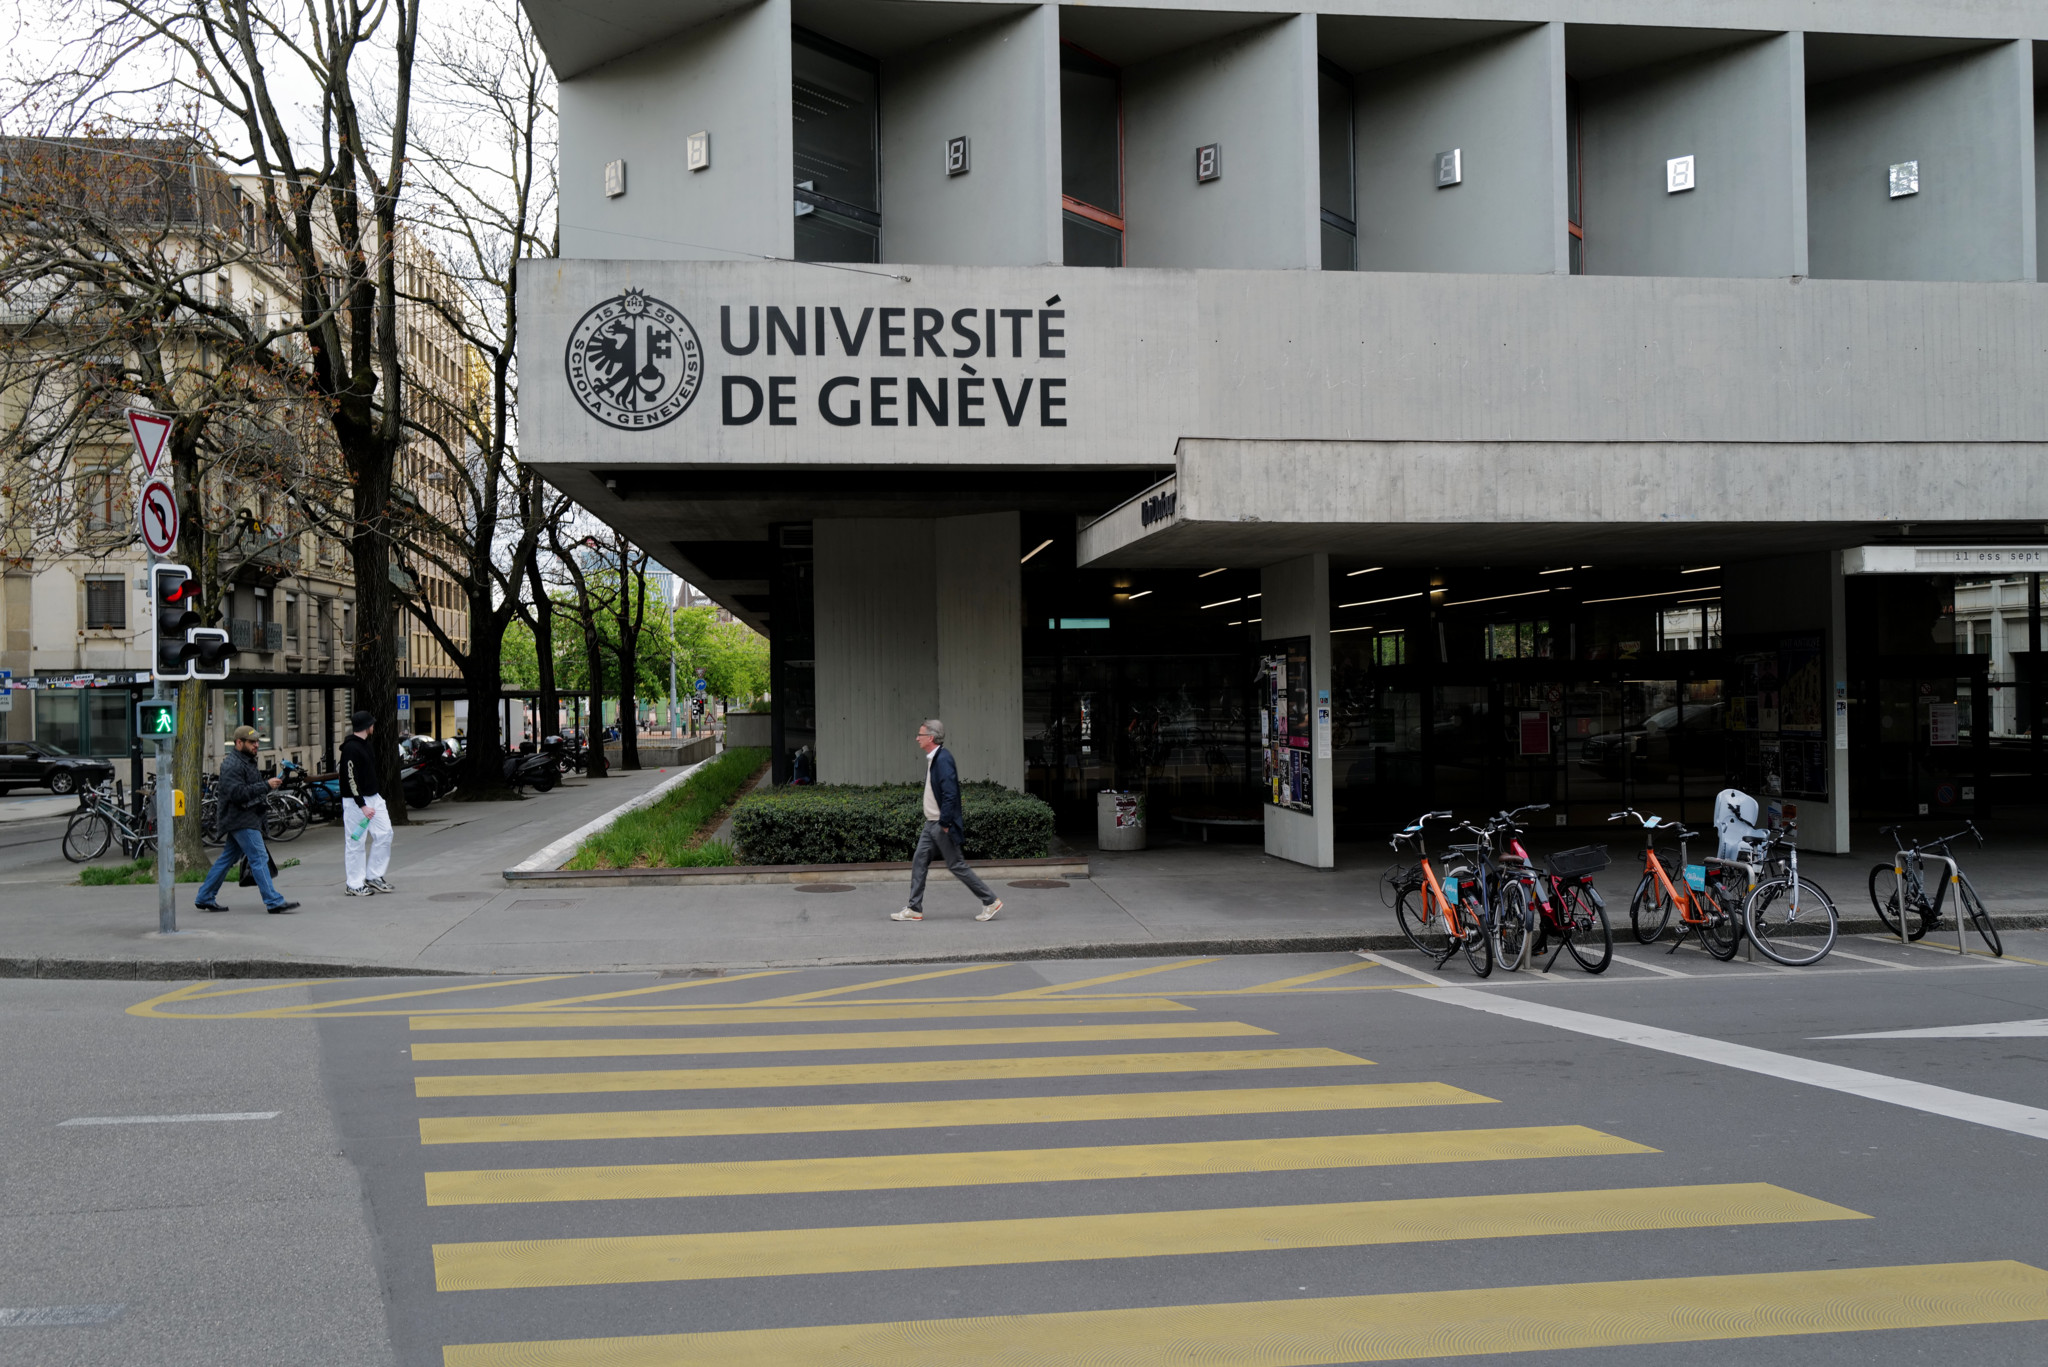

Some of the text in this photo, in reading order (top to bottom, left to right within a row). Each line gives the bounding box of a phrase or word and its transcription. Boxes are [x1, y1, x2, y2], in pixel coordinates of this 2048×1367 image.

[950, 140, 964, 170] 8
[1200, 147, 1215, 177] 8
[594, 307, 675, 324] 15 59
[720, 294, 1066, 359] UNIVERSITÉ
[572, 338, 698, 425] SCHOLA GENEVENSIS
[722, 363, 1068, 427] DE GENÈVE
[1955, 551, 2040, 562] il ess sept
